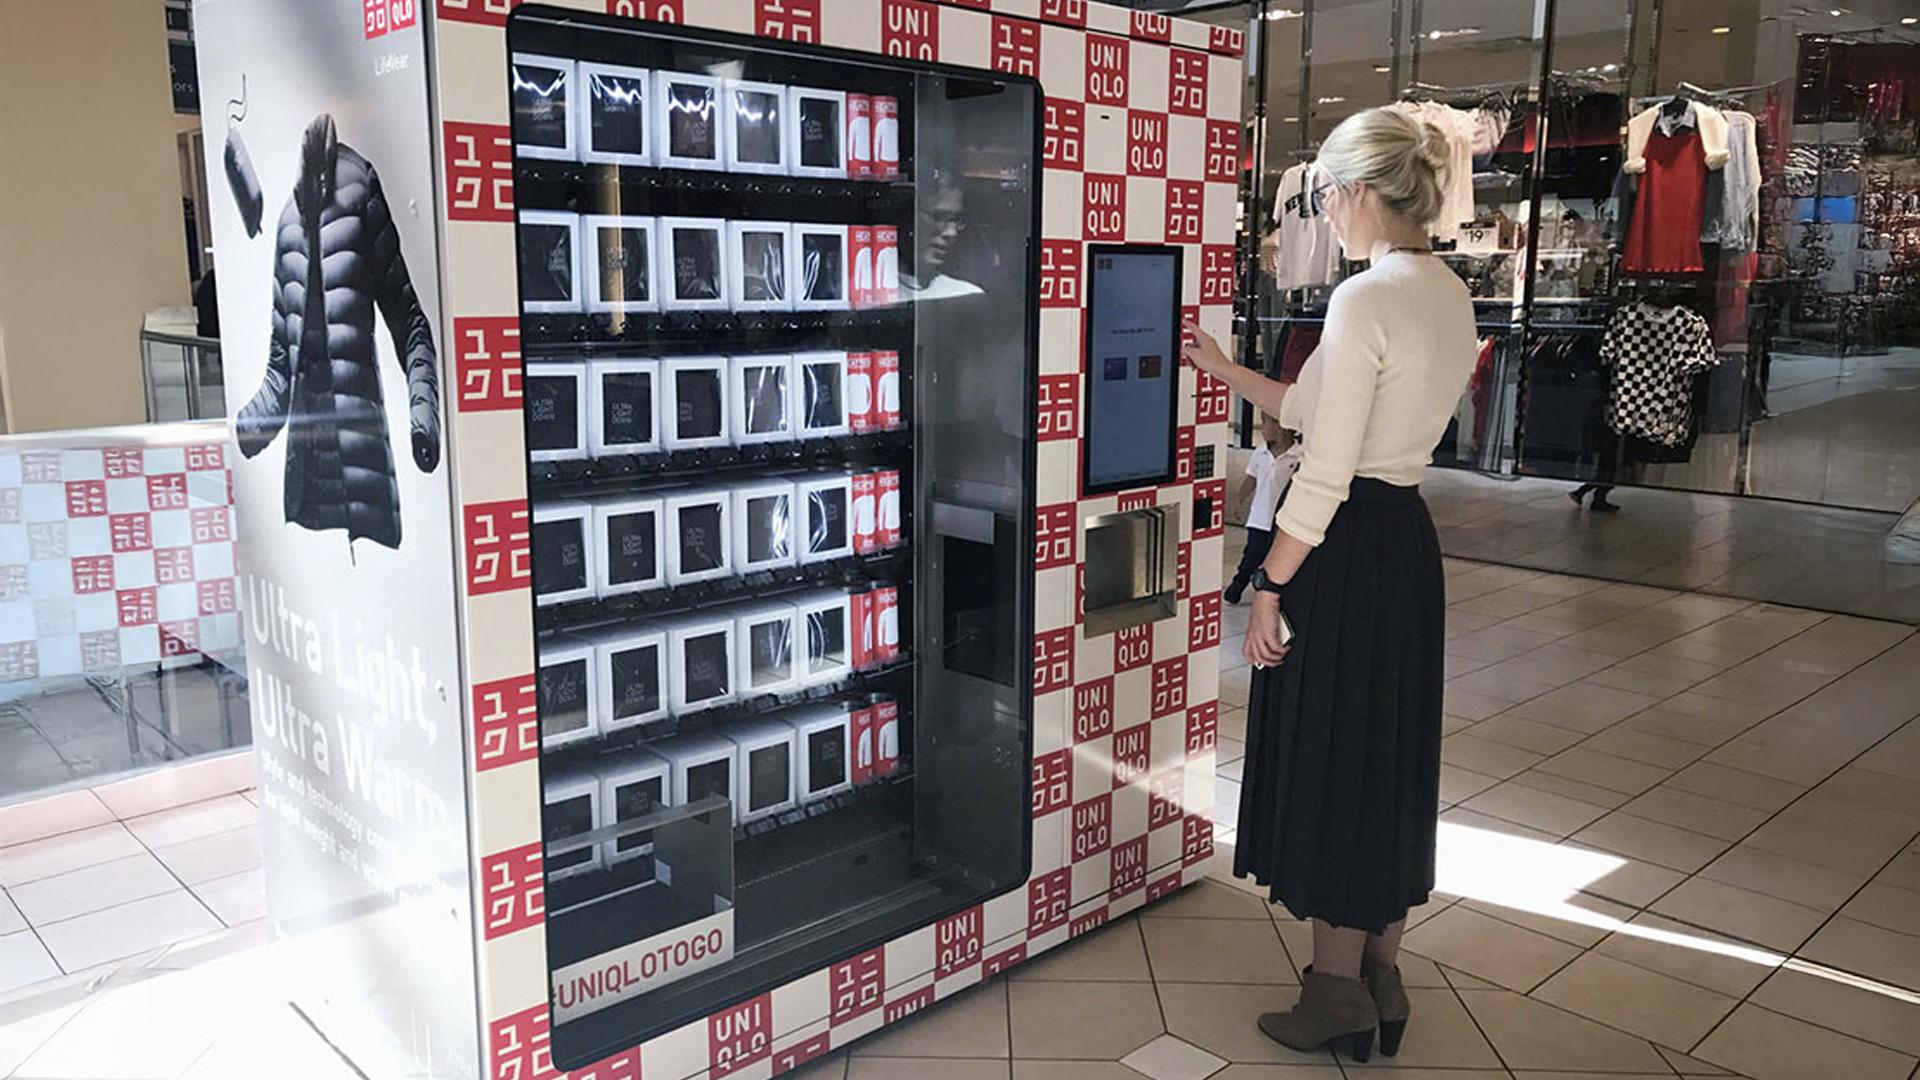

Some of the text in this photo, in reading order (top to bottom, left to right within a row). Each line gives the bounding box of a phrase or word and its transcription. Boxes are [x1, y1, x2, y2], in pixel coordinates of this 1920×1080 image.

[888, 5, 929, 37] UNI
[1135, 13, 1167, 34] QLO
[1091, 43, 1121, 70] UNI
[1090, 72, 1123, 100] QLO
[1132, 118, 1161, 142] UNI
[1131, 146, 1163, 171] QLO
[1088, 182, 1118, 205] UNI
[1087, 210, 1121, 236] QLO
[249, 574, 437, 746] Ultra Light,
[1118, 640, 1149, 666] QLO
[1078, 686, 1107, 710] UNI
[1078, 709, 1110, 738] QLO
[256, 667, 448, 827] Ultra Warm
[1117, 731, 1144, 756] UNI
[1116, 755, 1146, 783] QLO
[1077, 802, 1105, 829] UNI
[1076, 826, 1107, 855] QLO
[1115, 844, 1142, 870] UNI
[942, 912, 975, 944] UNI
[552, 928, 723, 1009] UNIQLOTOGO
[716, 1003, 760, 1042] UNI
